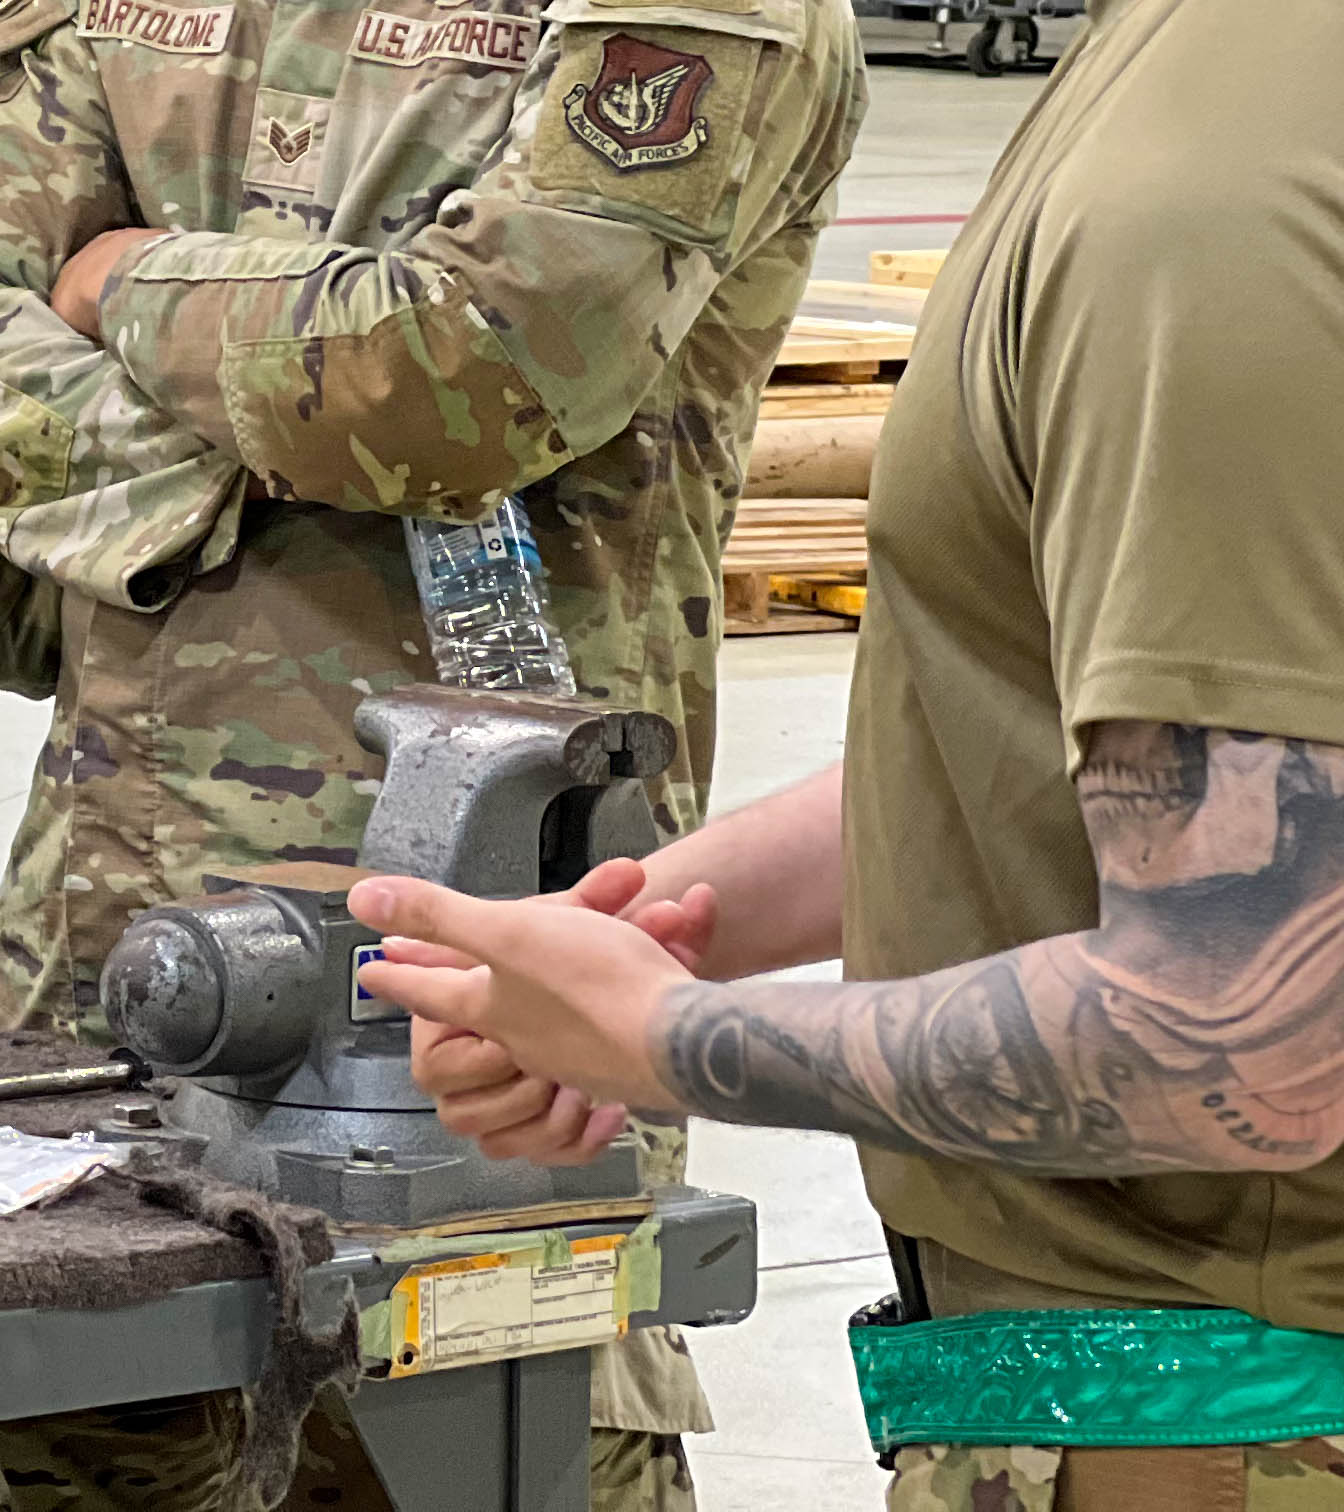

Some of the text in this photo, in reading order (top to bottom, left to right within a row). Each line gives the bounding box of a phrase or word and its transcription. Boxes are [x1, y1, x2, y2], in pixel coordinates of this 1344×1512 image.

[357, 20, 408, 59] U.S.
[437, 16, 532, 63] FORCE
[571, 114, 689, 165] PACIFIC AIR FORCES
